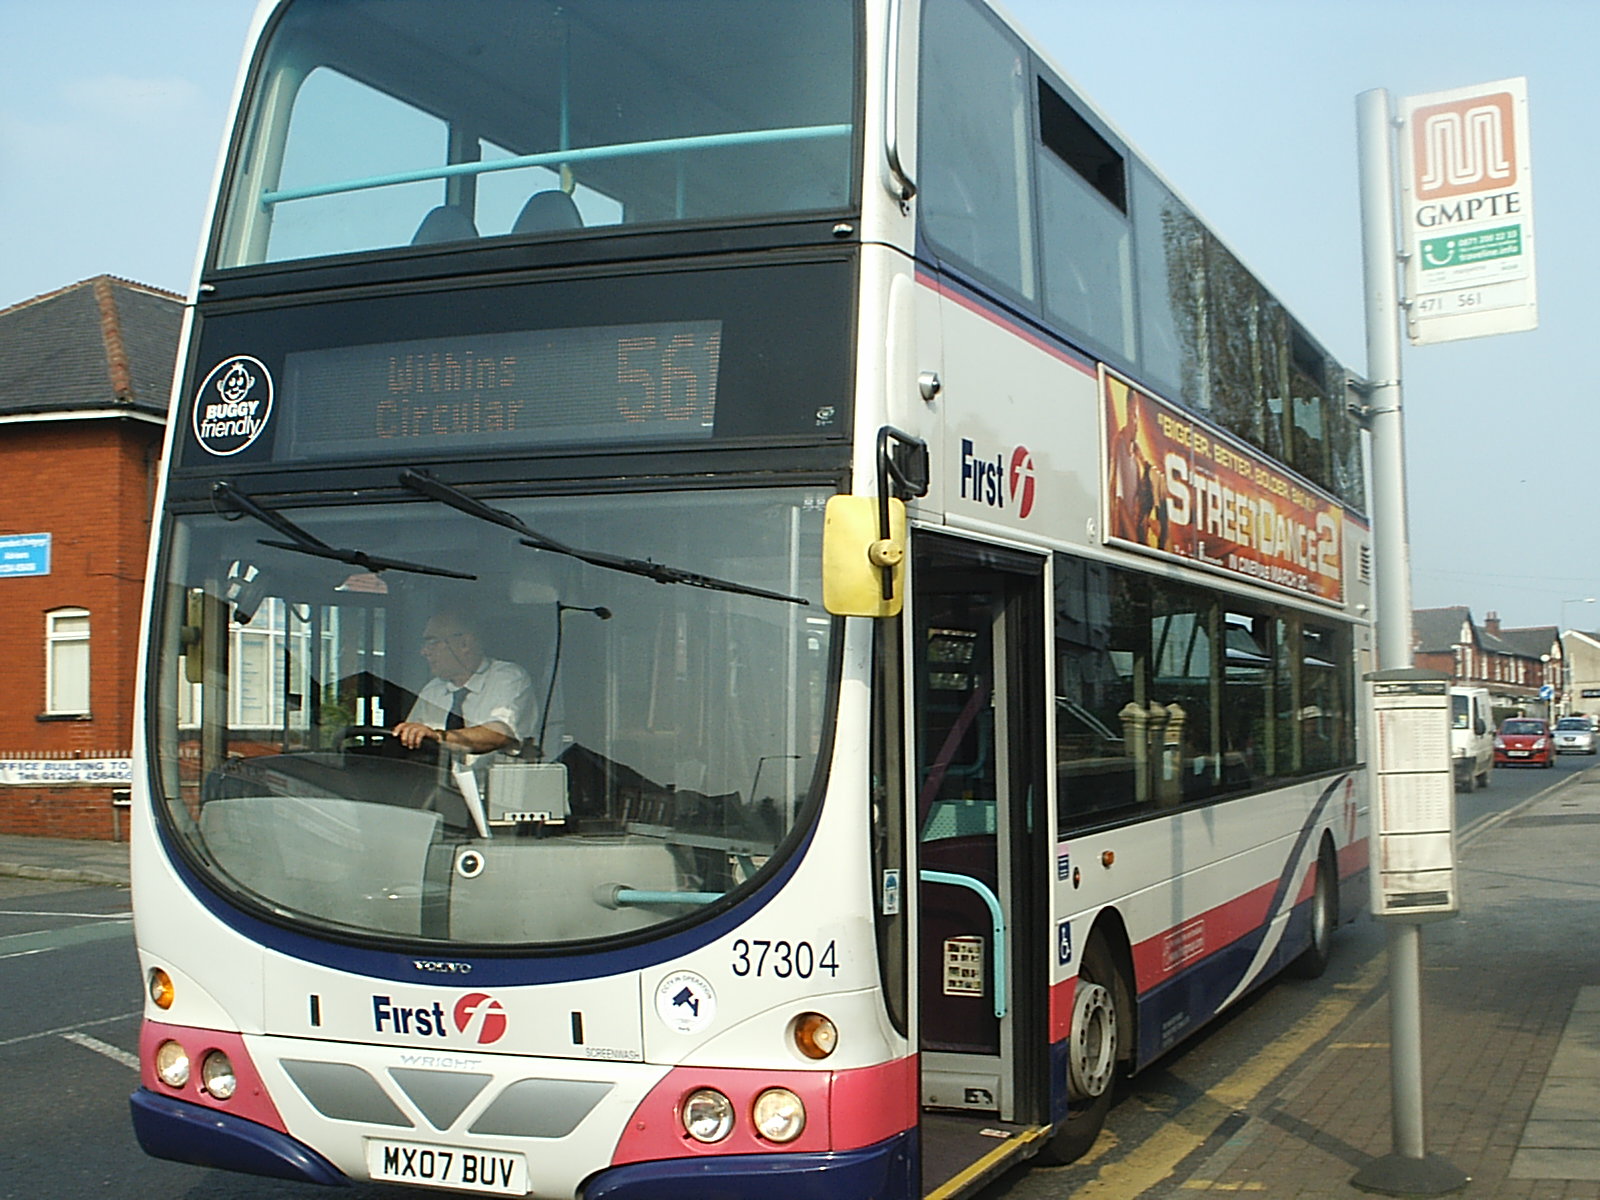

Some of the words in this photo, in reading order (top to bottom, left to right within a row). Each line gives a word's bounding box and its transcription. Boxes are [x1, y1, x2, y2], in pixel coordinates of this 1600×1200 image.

[1416, 191, 1521, 228] GMPTE
[1419, 298, 1442, 312] 471
[1458, 292, 1482, 307] 561
[388, 350, 517, 394] Withins
[617, 332, 720, 423] 561
[206, 400, 260, 419] BUGGY
[375, 394, 524, 439] Circular
[201, 415, 261, 439] friendly
[961, 438, 1003, 508] First
[1270, 564, 1298, 587] MARCH
[44, 762, 104, 771] BUILDING
[110, 761, 129, 770] TO
[413, 960, 472, 974] VOLVO
[732, 938, 840, 979] 37304
[682, 975, 712, 999] OPERATION
[372, 994, 447, 1037] First
[400, 1054, 482, 1070] WRIGHT
[585, 1047, 640, 1060] SCREENWASH
[384, 1146, 453, 1180] MX07
[462, 1154, 514, 1188] BUV
